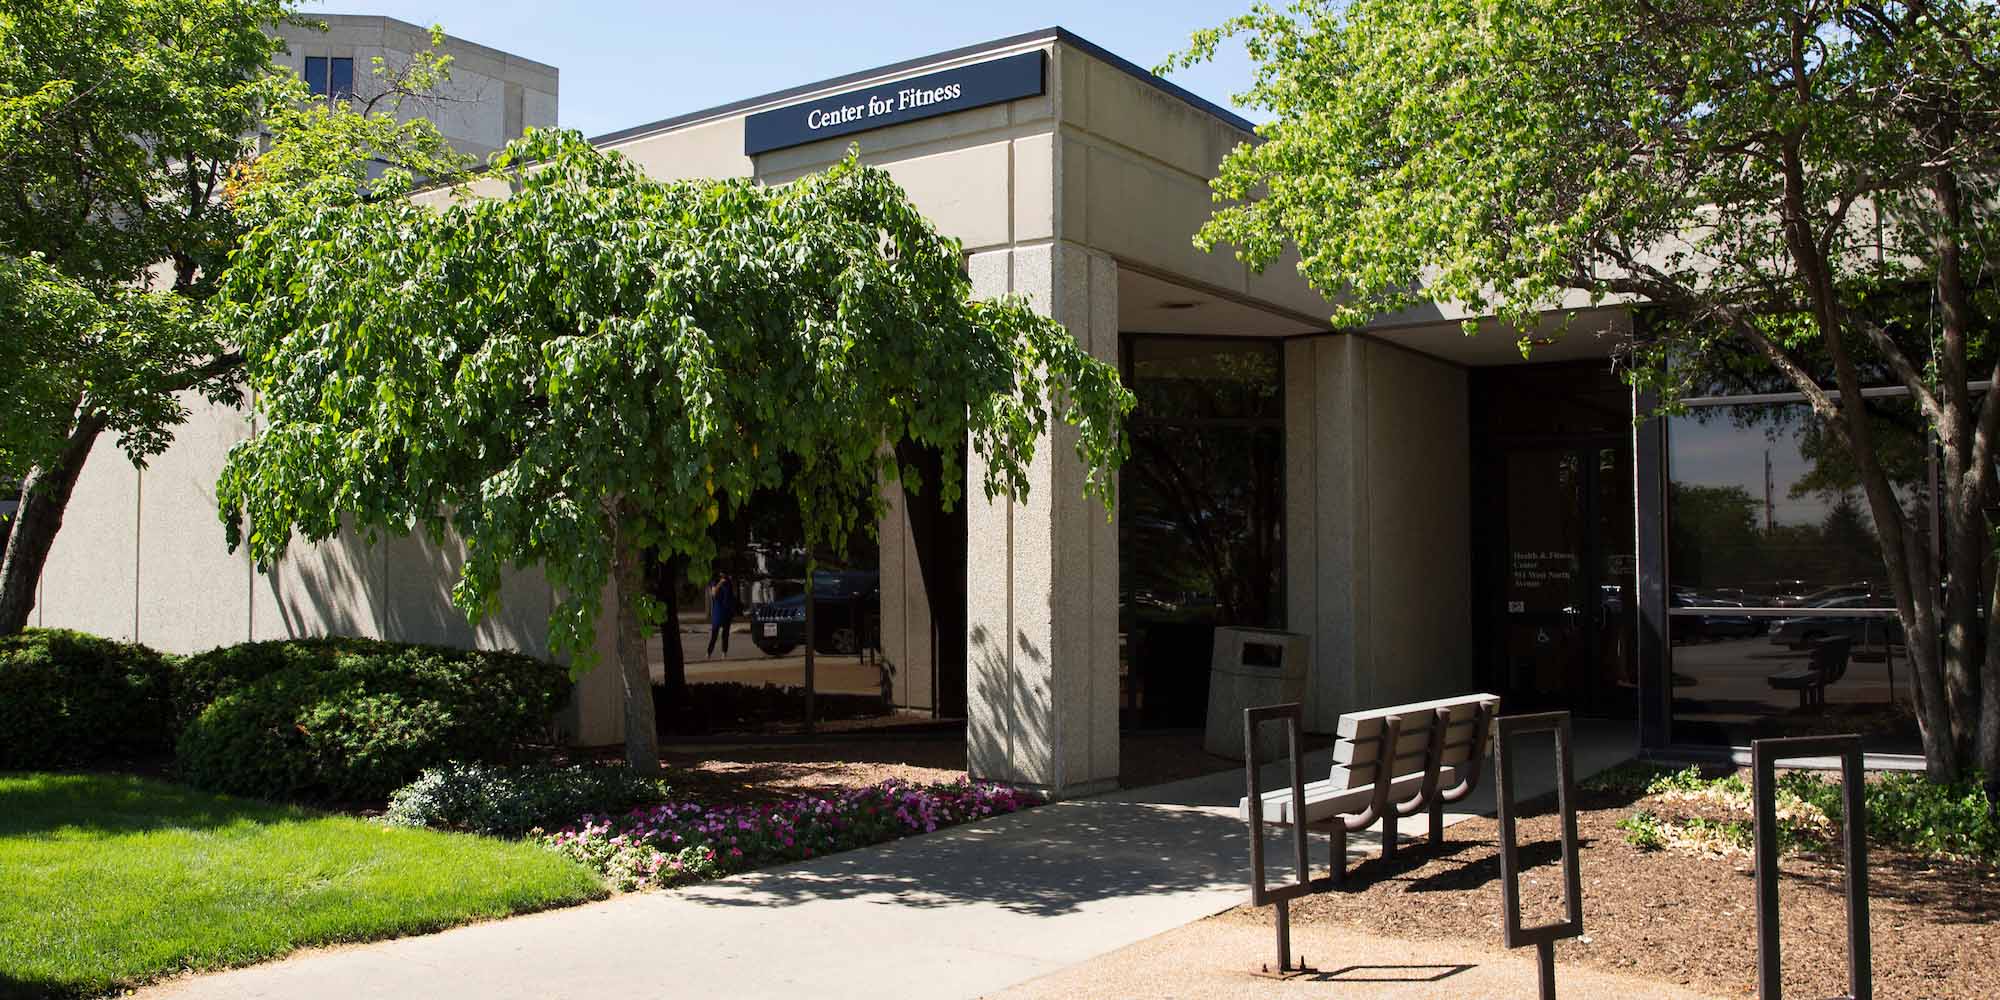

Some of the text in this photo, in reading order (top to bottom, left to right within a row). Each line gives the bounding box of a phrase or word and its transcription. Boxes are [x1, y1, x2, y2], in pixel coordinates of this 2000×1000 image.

[807, 83, 961, 130] Center for Fitness
